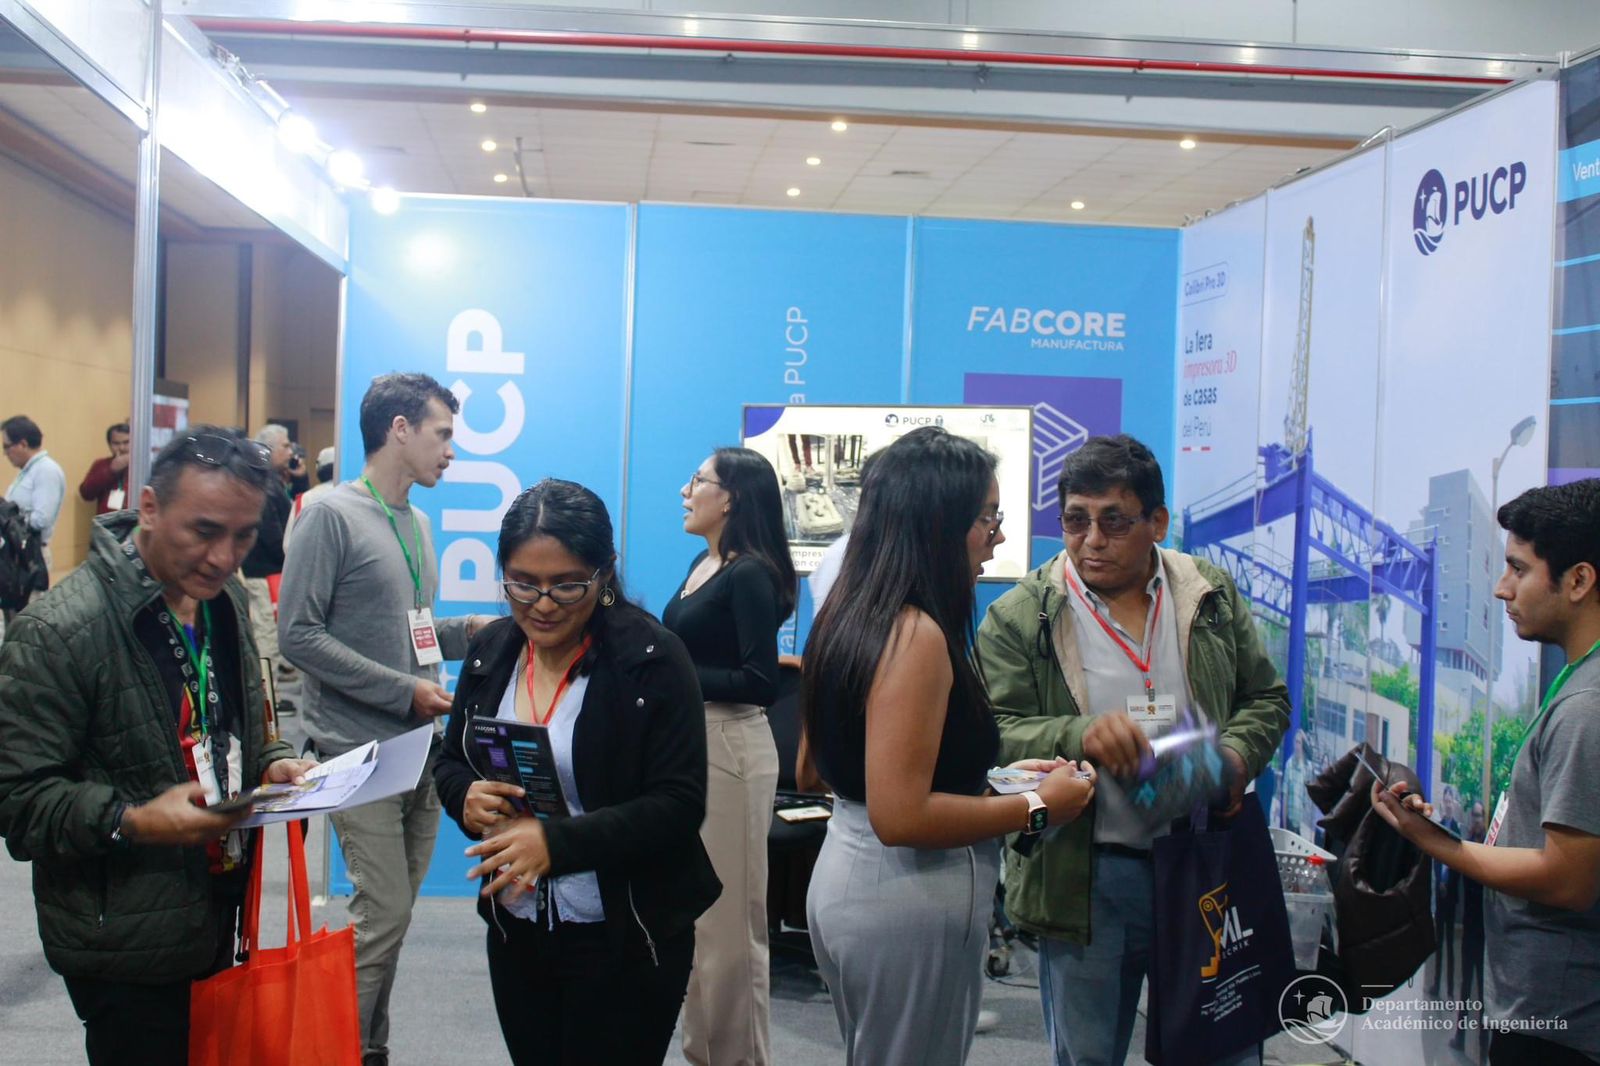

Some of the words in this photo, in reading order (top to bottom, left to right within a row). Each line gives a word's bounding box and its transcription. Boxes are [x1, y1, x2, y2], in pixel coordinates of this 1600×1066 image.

[1454, 161, 1526, 226] PUCP
[966, 306, 1127, 338] FABCORE
[784, 306, 808, 385] PUCP
[1031, 338, 1125, 352] MANUFACTURA
[1184, 336, 1194, 354] La
[1195, 330, 1213, 352] 1era
[1183, 358, 1223, 384] impresora
[1224, 350, 1238, 374] 3D
[1183, 389, 1193, 406] de
[1193, 387, 1218, 405] casas
[902, 416, 932, 426] PUCP
[439, 308, 526, 602] PUCP
